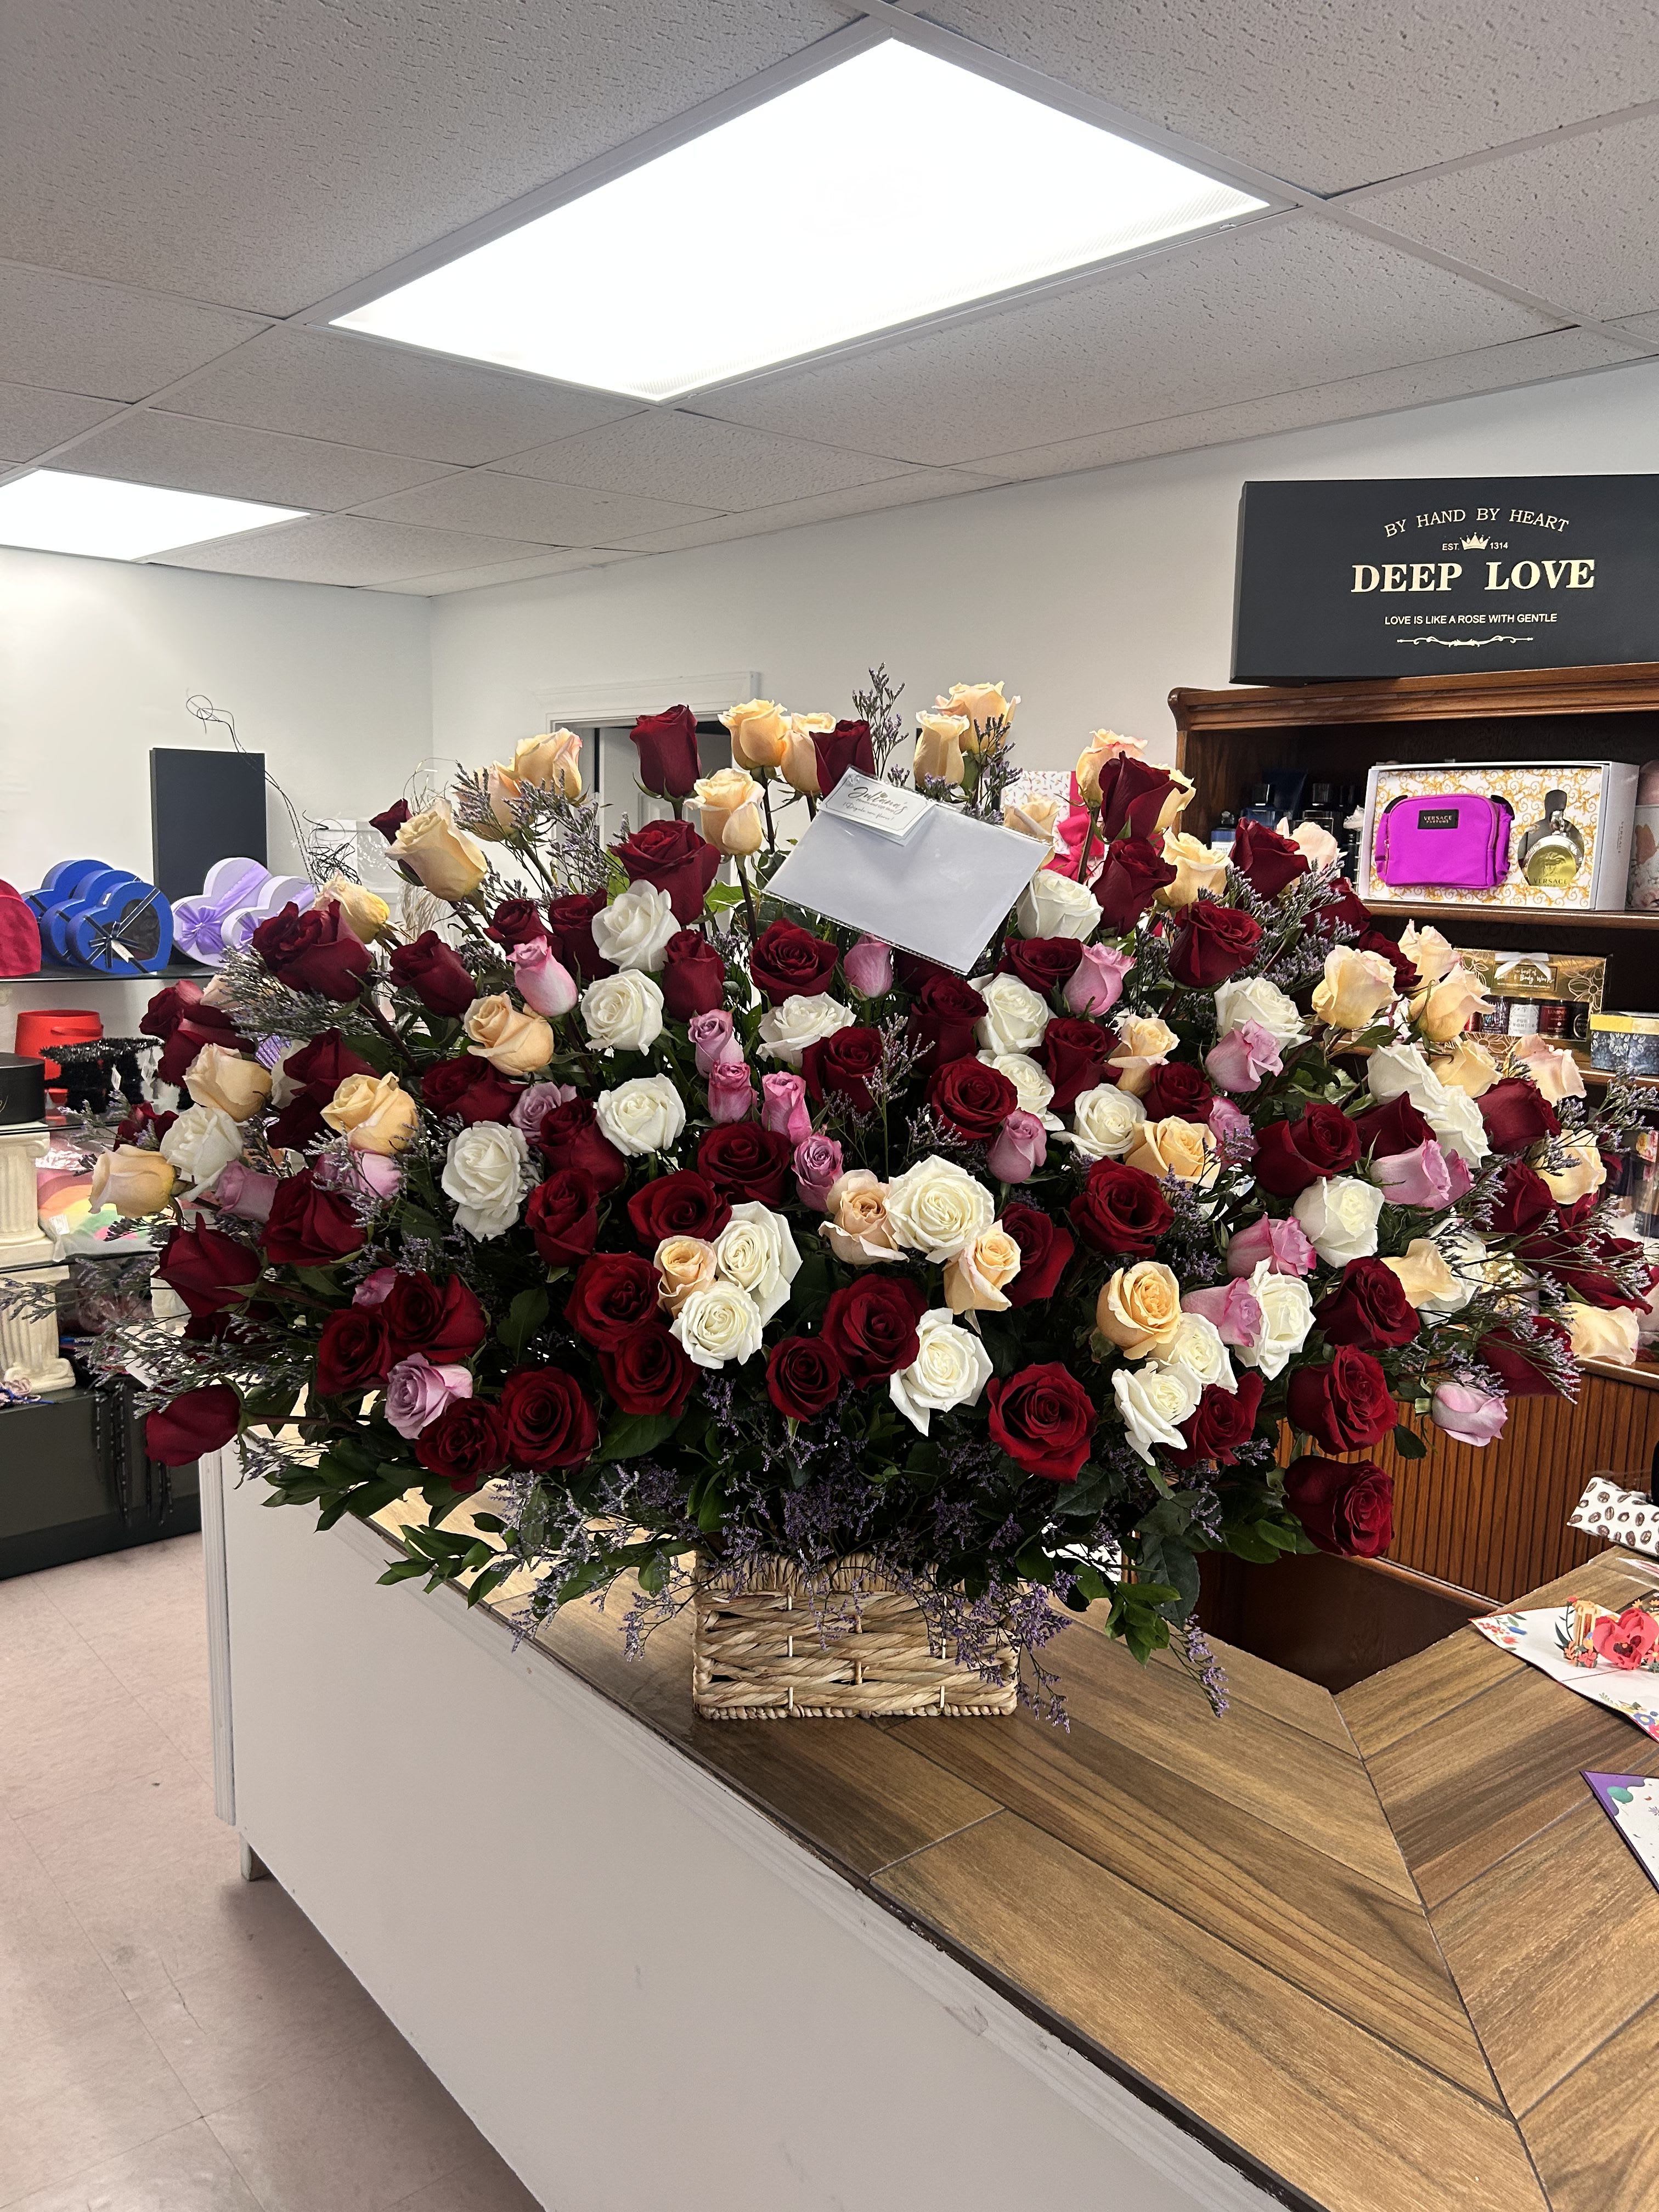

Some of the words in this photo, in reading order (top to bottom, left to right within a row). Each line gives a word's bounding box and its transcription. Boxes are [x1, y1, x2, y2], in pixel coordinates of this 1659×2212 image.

[1384, 519, 1407, 538] BY
[1416, 509, 1466, 528] HAND
[1476, 508, 1500, 521] BY
[1509, 509, 1569, 532] HEART
[1442, 543, 1460, 551] EST.
[1489, 541, 1508, 550] 1314
[1350, 563, 1463, 592] DEEP
[1484, 559, 1595, 590] LOVE
[1385, 616, 1412, 625] LOVE
[1413, 616, 1423, 625] IS
[1425, 615, 1447, 624] LIKE
[1448, 615, 1456, 624] A
[1458, 614, 1486, 624] ROSE
[1488, 614, 1515, 623] WITH
[1516, 613, 1558, 623] GENTLE
